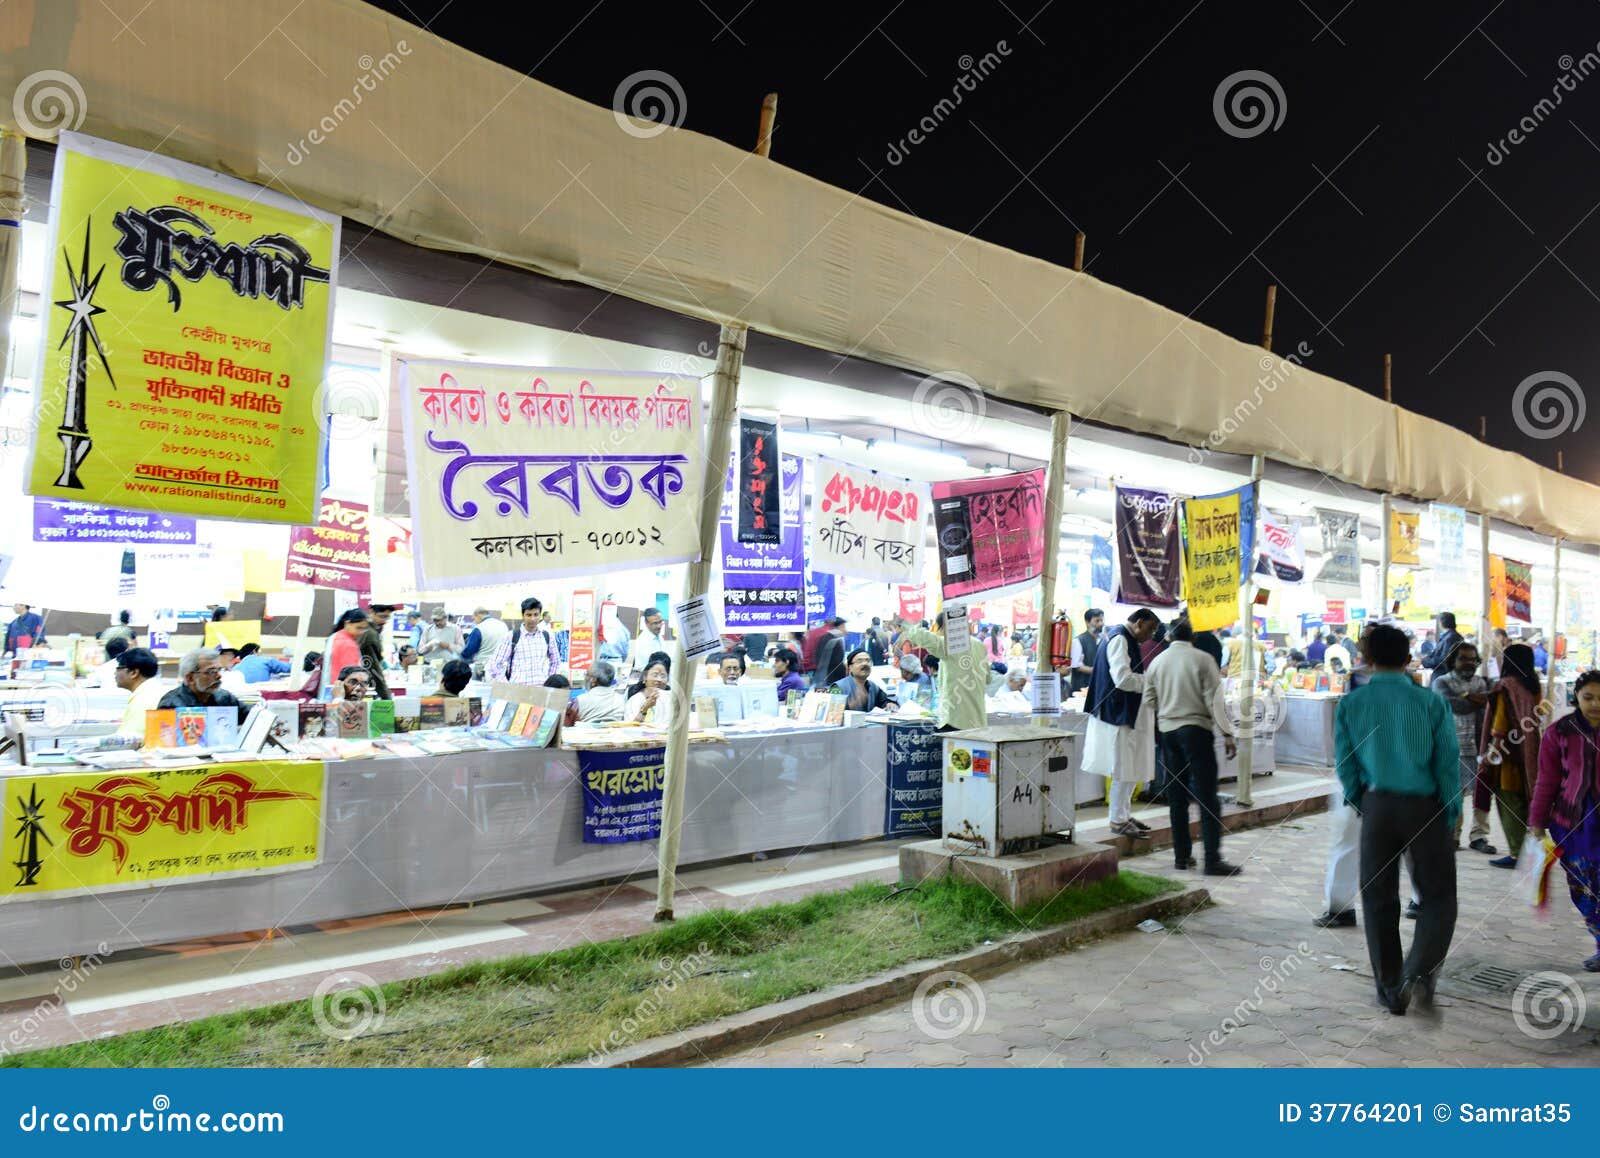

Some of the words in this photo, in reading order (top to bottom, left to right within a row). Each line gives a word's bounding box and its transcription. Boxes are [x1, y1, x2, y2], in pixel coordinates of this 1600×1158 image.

[112, 205, 331, 313] যুক্তিবাদী
[143, 349, 213, 376] ভারতীয়
[218, 358, 273, 385] বিজ্ঞান
[277, 374, 291, 389] ও
[146, 377, 225, 406] যুক্তিবাদী
[230, 391, 283, 415] সমিতি
[418, 373, 488, 427] কবিতা
[496, 391, 511, 424] ও
[515, 378, 575, 428] কবিতা
[579, 380, 641, 428] বিষয়ক
[645, 384, 692, 430] পত্রিকা
[225, 470, 279, 490] ঠিকানা
[425, 429, 688, 521] রৈবতক
[124, 481, 287, 508] www.rationalistindia.org
[471, 532, 563, 558] কলকাতা
[587, 525, 664, 551] ৭০০০১২
[872, 537, 915, 568] বছর
[748, 590, 757, 601] ও
[60, 771, 317, 875] যুক্তিবাদী
